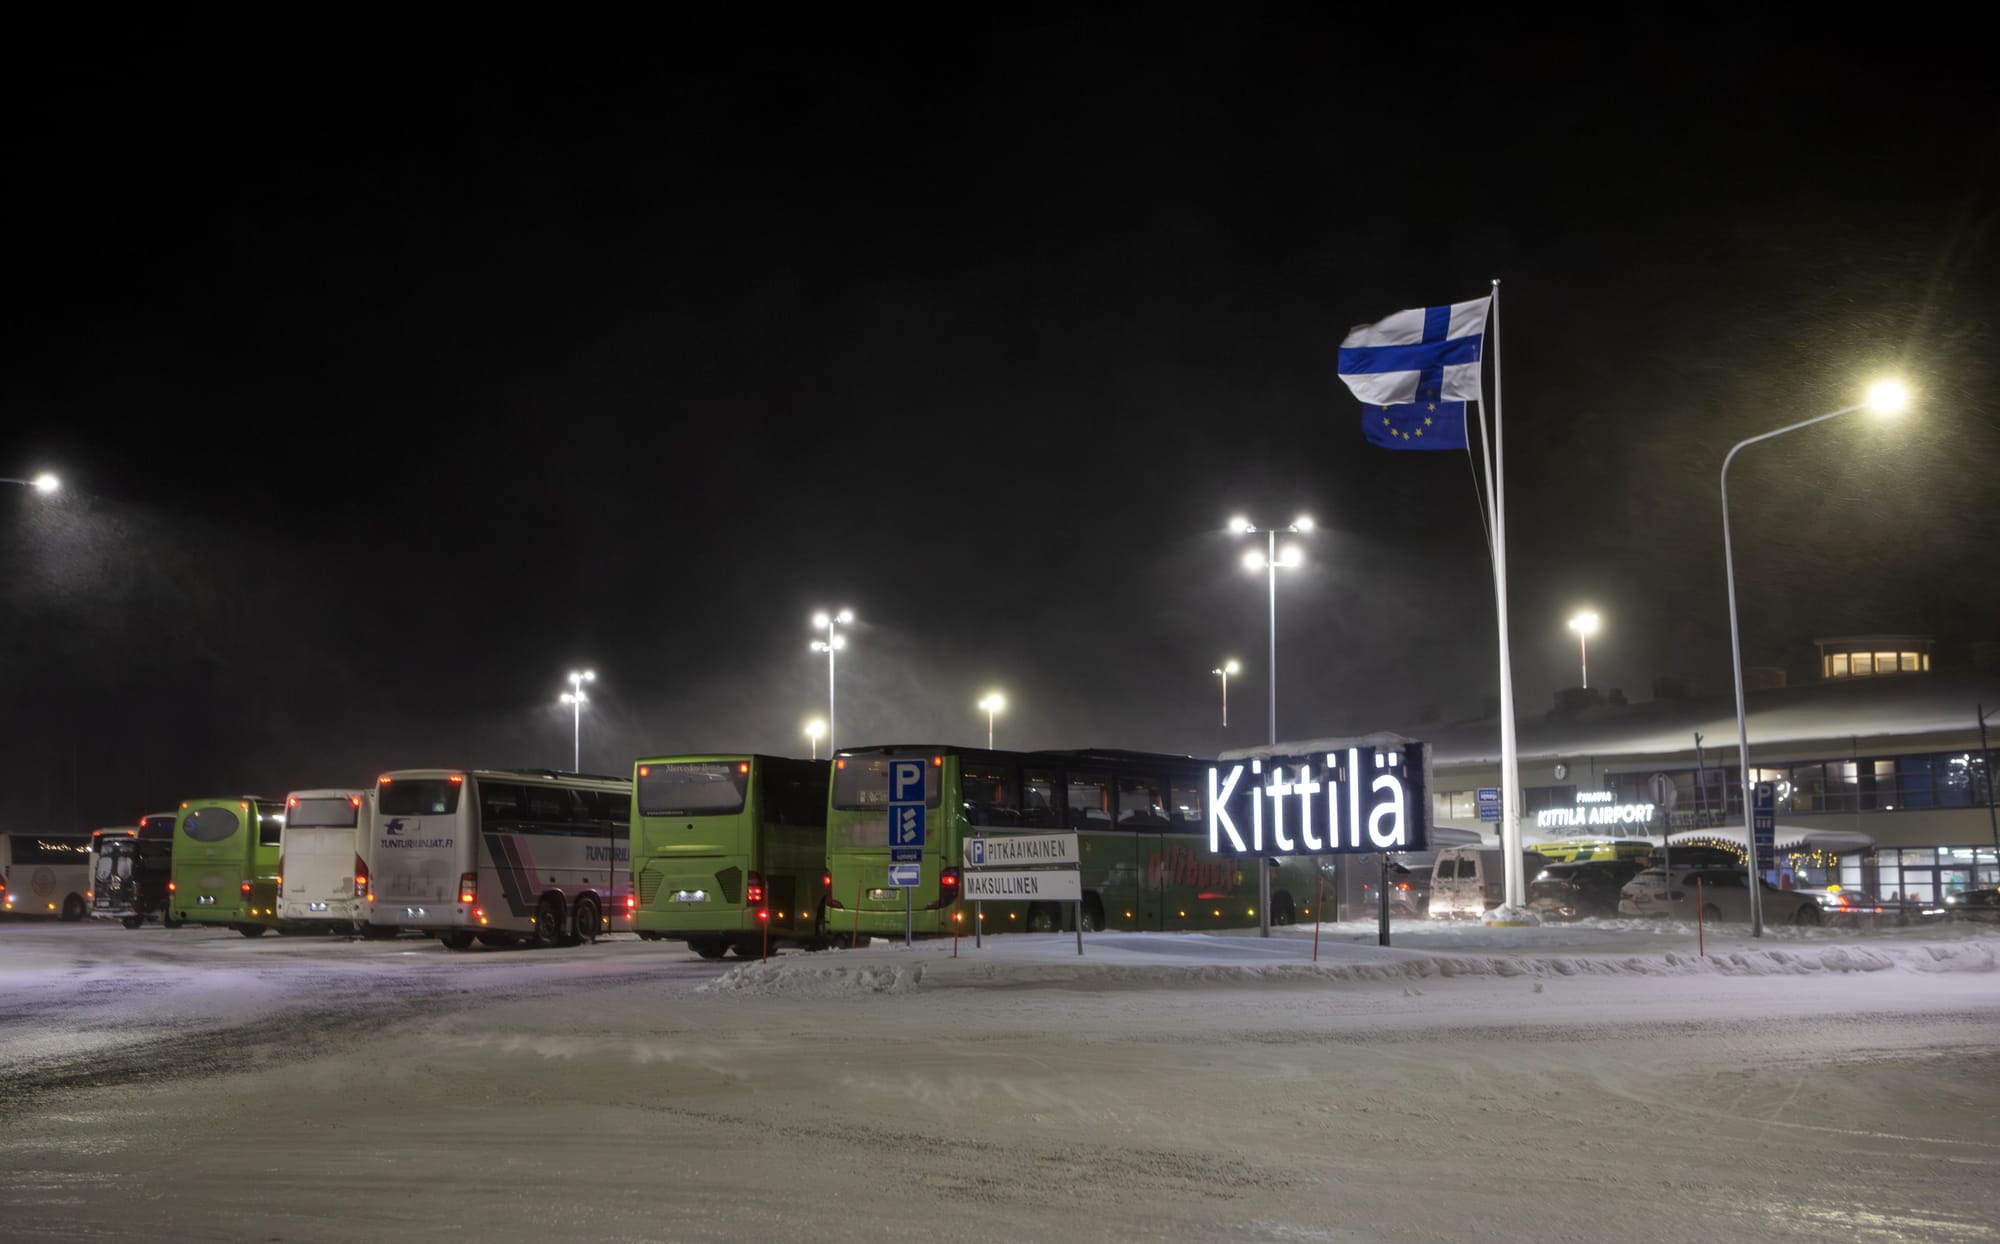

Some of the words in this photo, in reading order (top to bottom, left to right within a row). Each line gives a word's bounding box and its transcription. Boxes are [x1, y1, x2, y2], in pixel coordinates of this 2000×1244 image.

[896, 763, 921, 800] P
[1208, 747, 1405, 853] Kittilä
[1538, 806, 1586, 827] KITTILÄ
[1588, 803, 1654, 825] AIRPORT
[988, 839, 1066, 860] PITKÄAIKAINEN
[967, 877, 1039, 895] MAKSULLINEN
